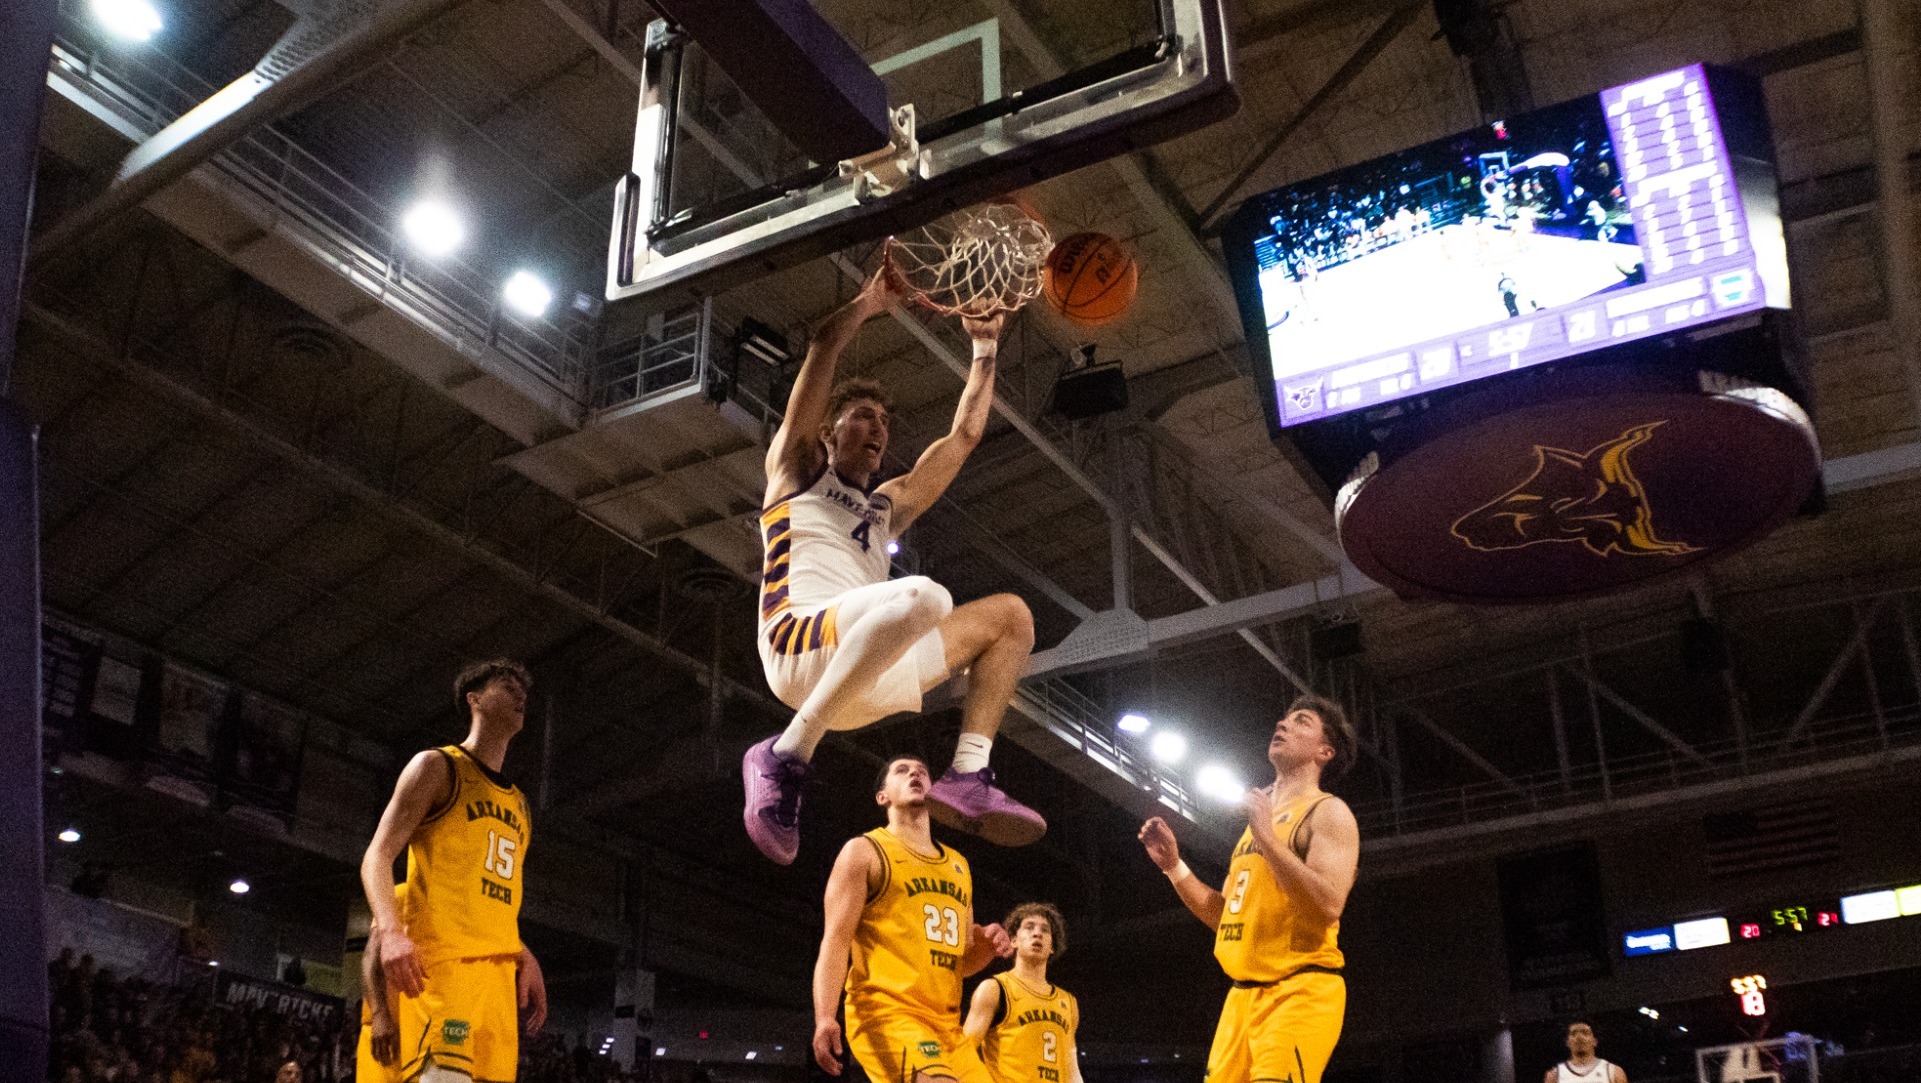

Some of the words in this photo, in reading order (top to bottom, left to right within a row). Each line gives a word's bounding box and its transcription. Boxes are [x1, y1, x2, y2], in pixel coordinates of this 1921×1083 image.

[851, 520, 871, 553] 4
[484, 829, 516, 880] 15
[481, 877, 512, 905] TECH
[904, 878, 967, 907] ARKANSAS
[923, 903, 960, 948] 23
[930, 949, 958, 970] TECH
[1018, 1010, 1069, 1034] ARKANSAS
[1042, 1031, 1057, 1063] 2
[1038, 1066, 1060, 1083] TECH
